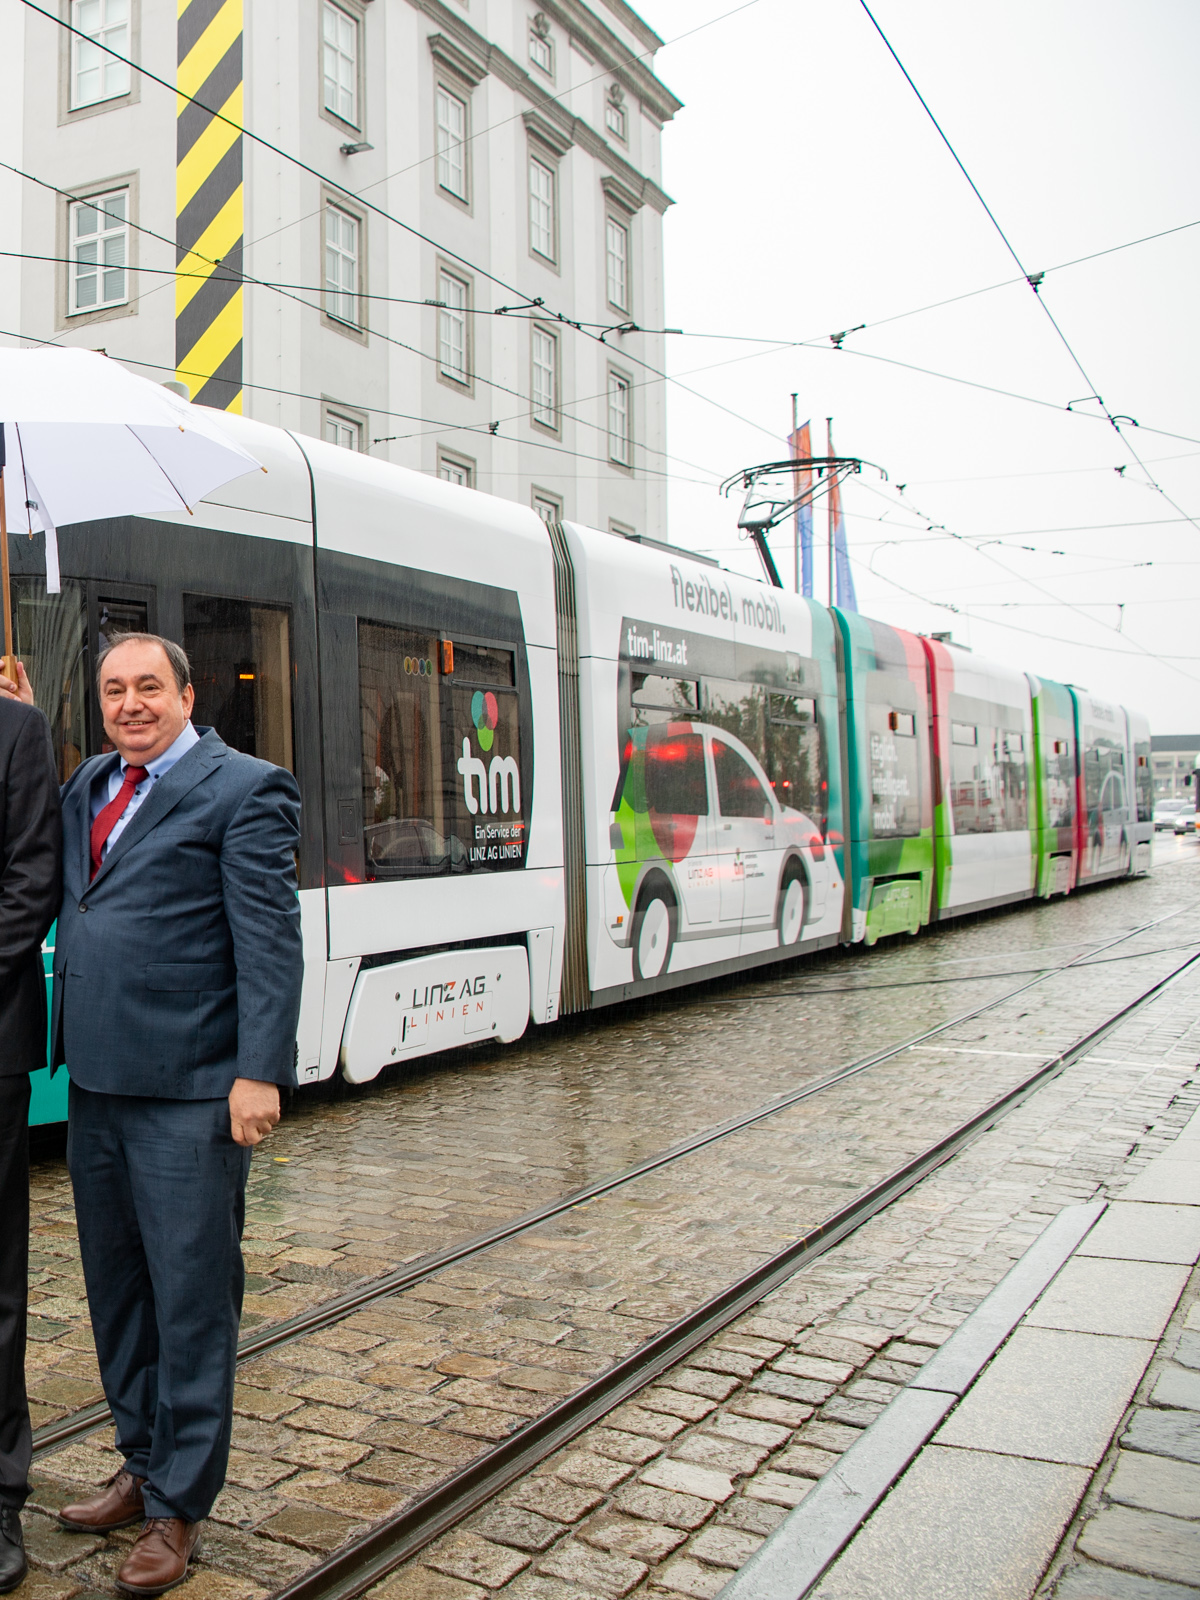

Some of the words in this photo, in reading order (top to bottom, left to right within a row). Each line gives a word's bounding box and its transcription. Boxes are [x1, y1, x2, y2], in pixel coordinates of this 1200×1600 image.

[670, 564, 738, 622] flexibel.
[742, 592, 786, 634] mobil.
[627, 625, 688, 666] tim-linz.at
[457, 736, 521, 814] tim
[475, 825, 485, 840] Ein
[486, 825, 509, 840] Service
[510, 825, 521, 838] der
[469, 847, 487, 862] LINZ
[487, 846, 498, 861] AG
[500, 845, 522, 860] LINIEN
[412, 981, 456, 1009] LINZ
[459, 975, 485, 999] AG
[410, 1000, 484, 1028] LINIEN
